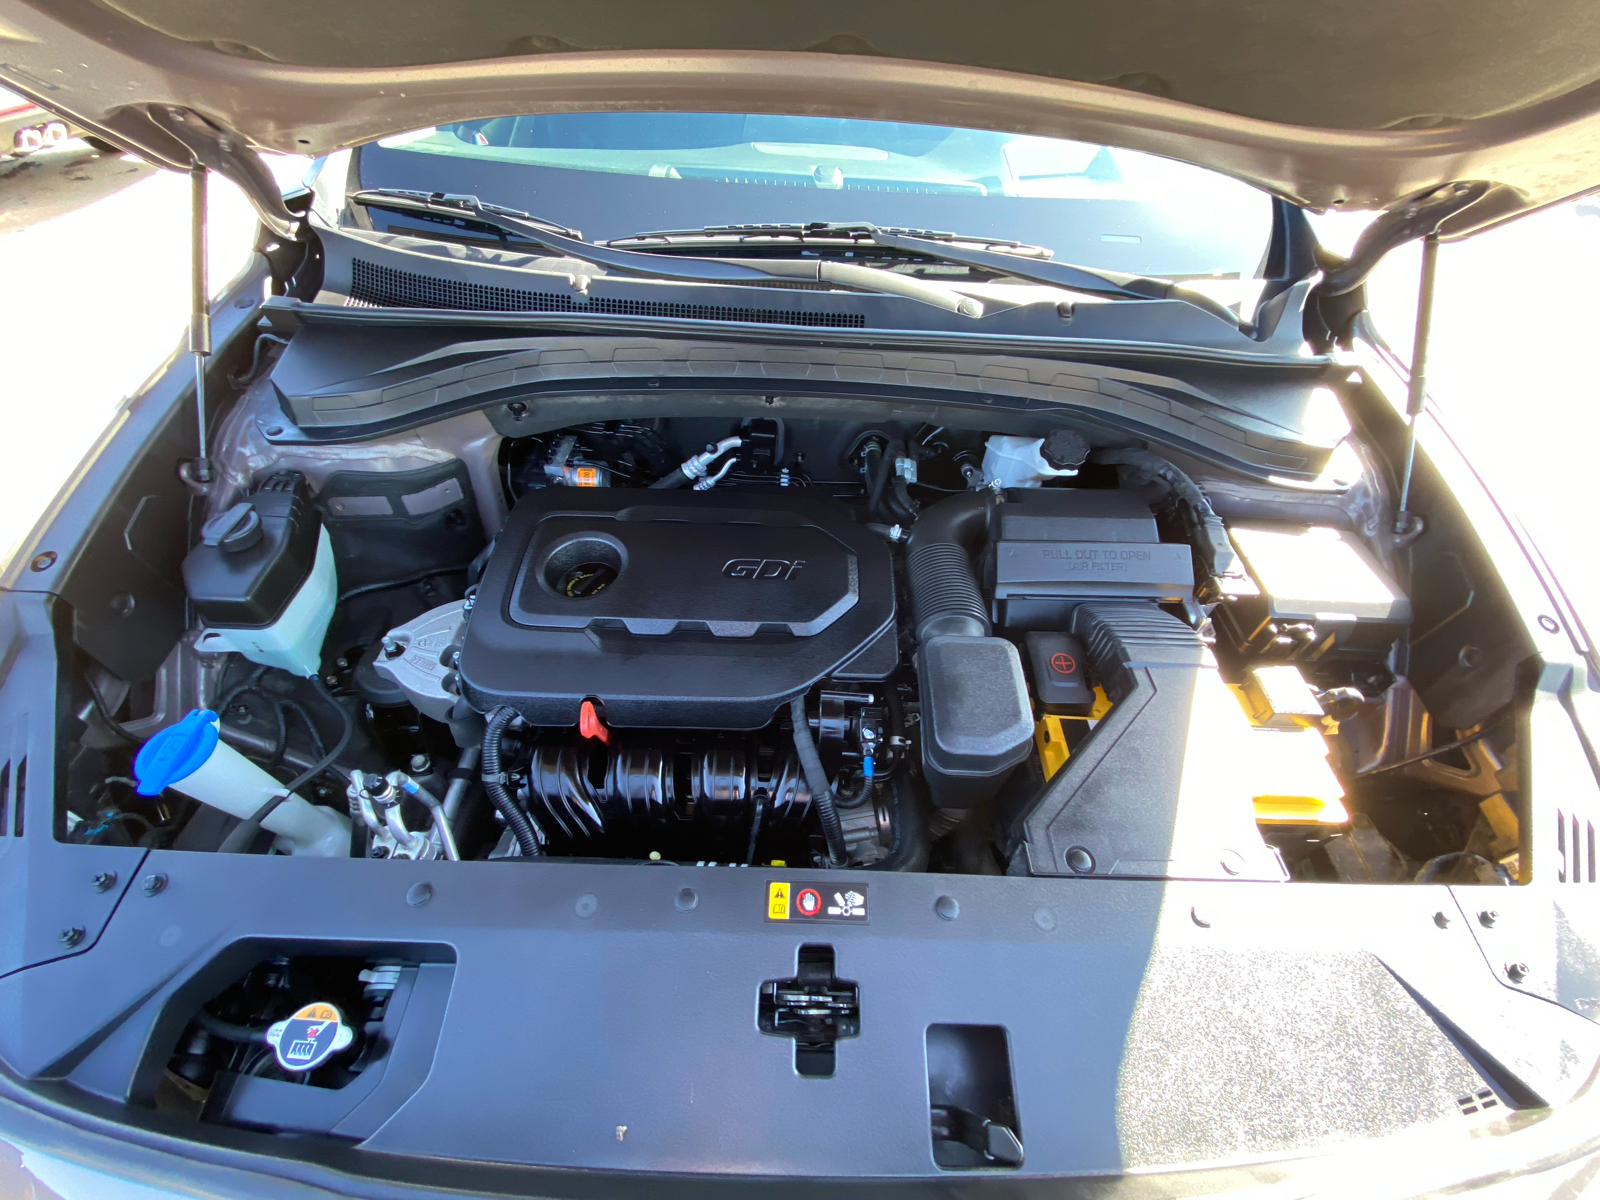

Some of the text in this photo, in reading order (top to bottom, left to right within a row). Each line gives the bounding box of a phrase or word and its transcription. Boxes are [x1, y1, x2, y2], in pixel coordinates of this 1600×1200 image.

[1042, 549, 1151, 561] PULL OUT TO OPEN
